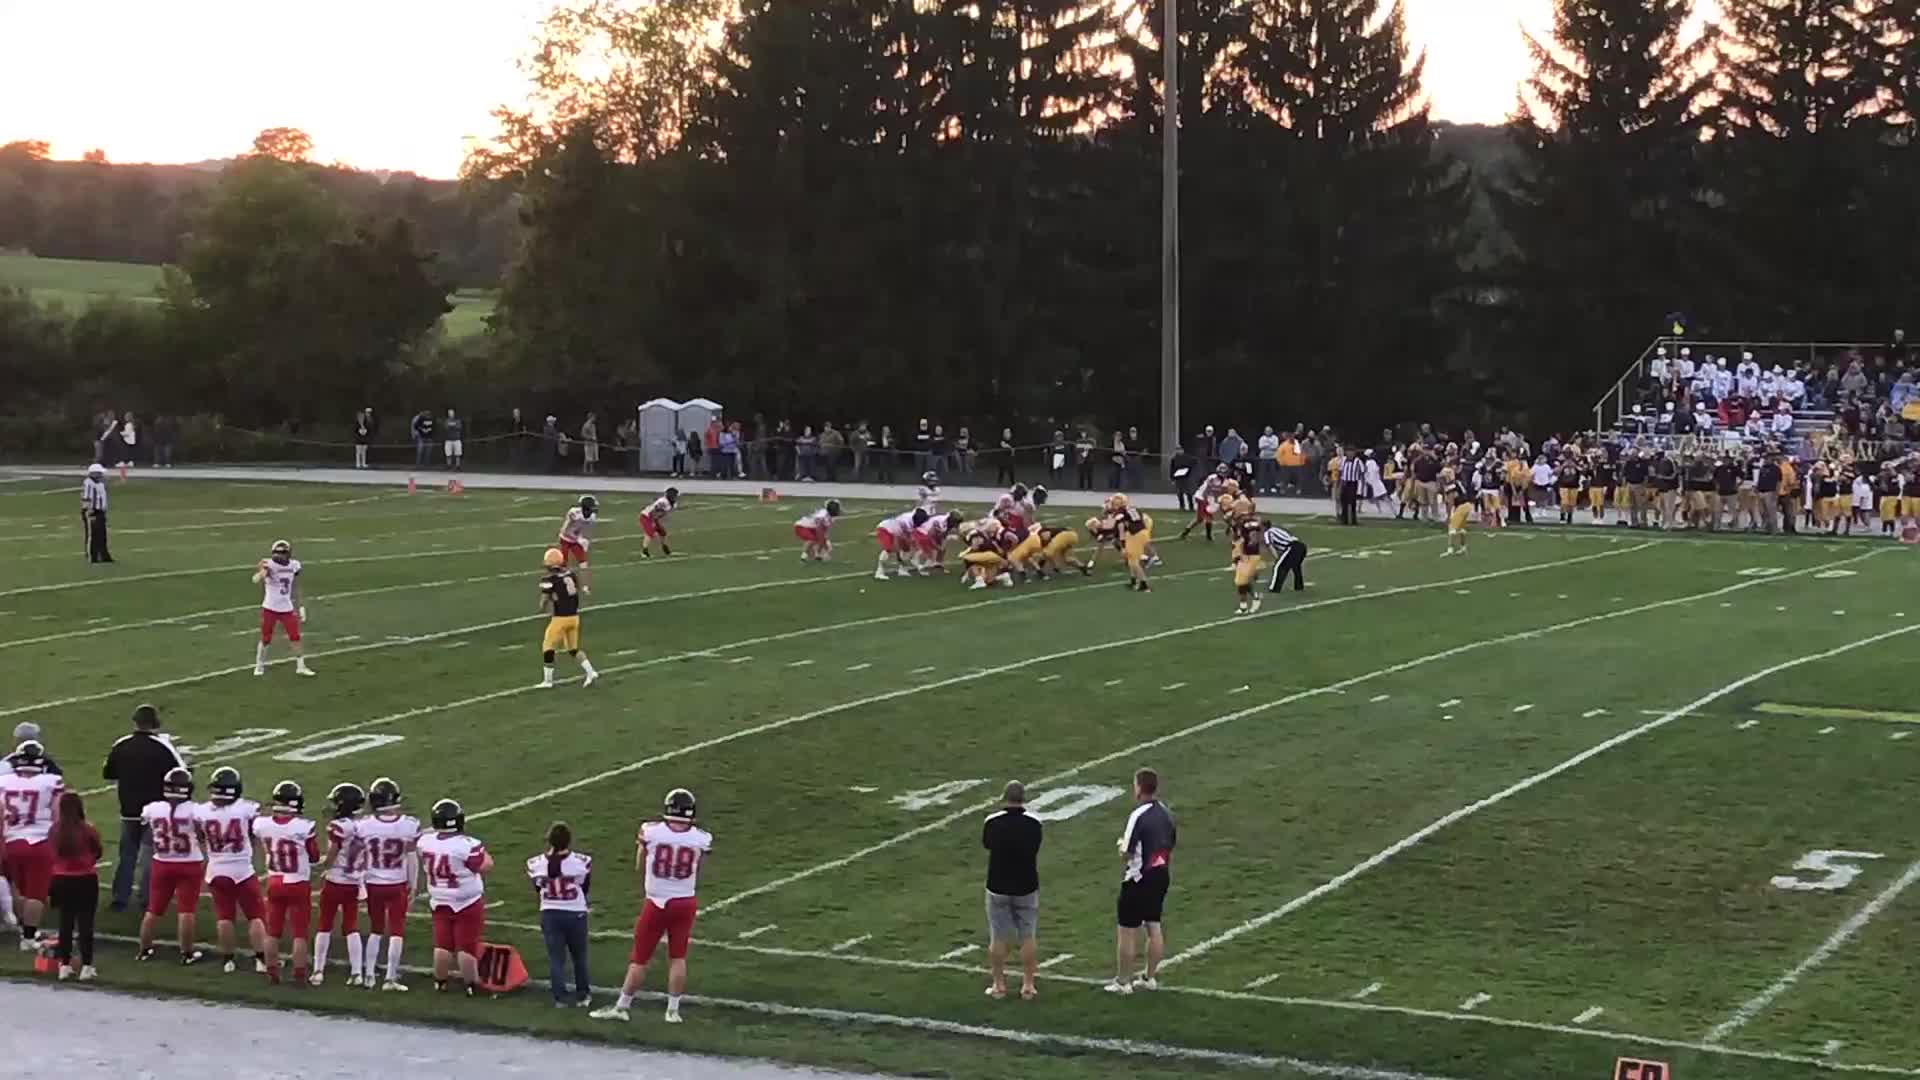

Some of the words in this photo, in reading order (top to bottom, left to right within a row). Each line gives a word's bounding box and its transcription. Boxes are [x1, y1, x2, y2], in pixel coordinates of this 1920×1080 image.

[3, 790, 40, 826] 57
[152, 816, 192, 853] 35
[367, 838, 404, 870] 12
[422, 851, 461, 889] 74
[651, 844, 695, 880] 88
